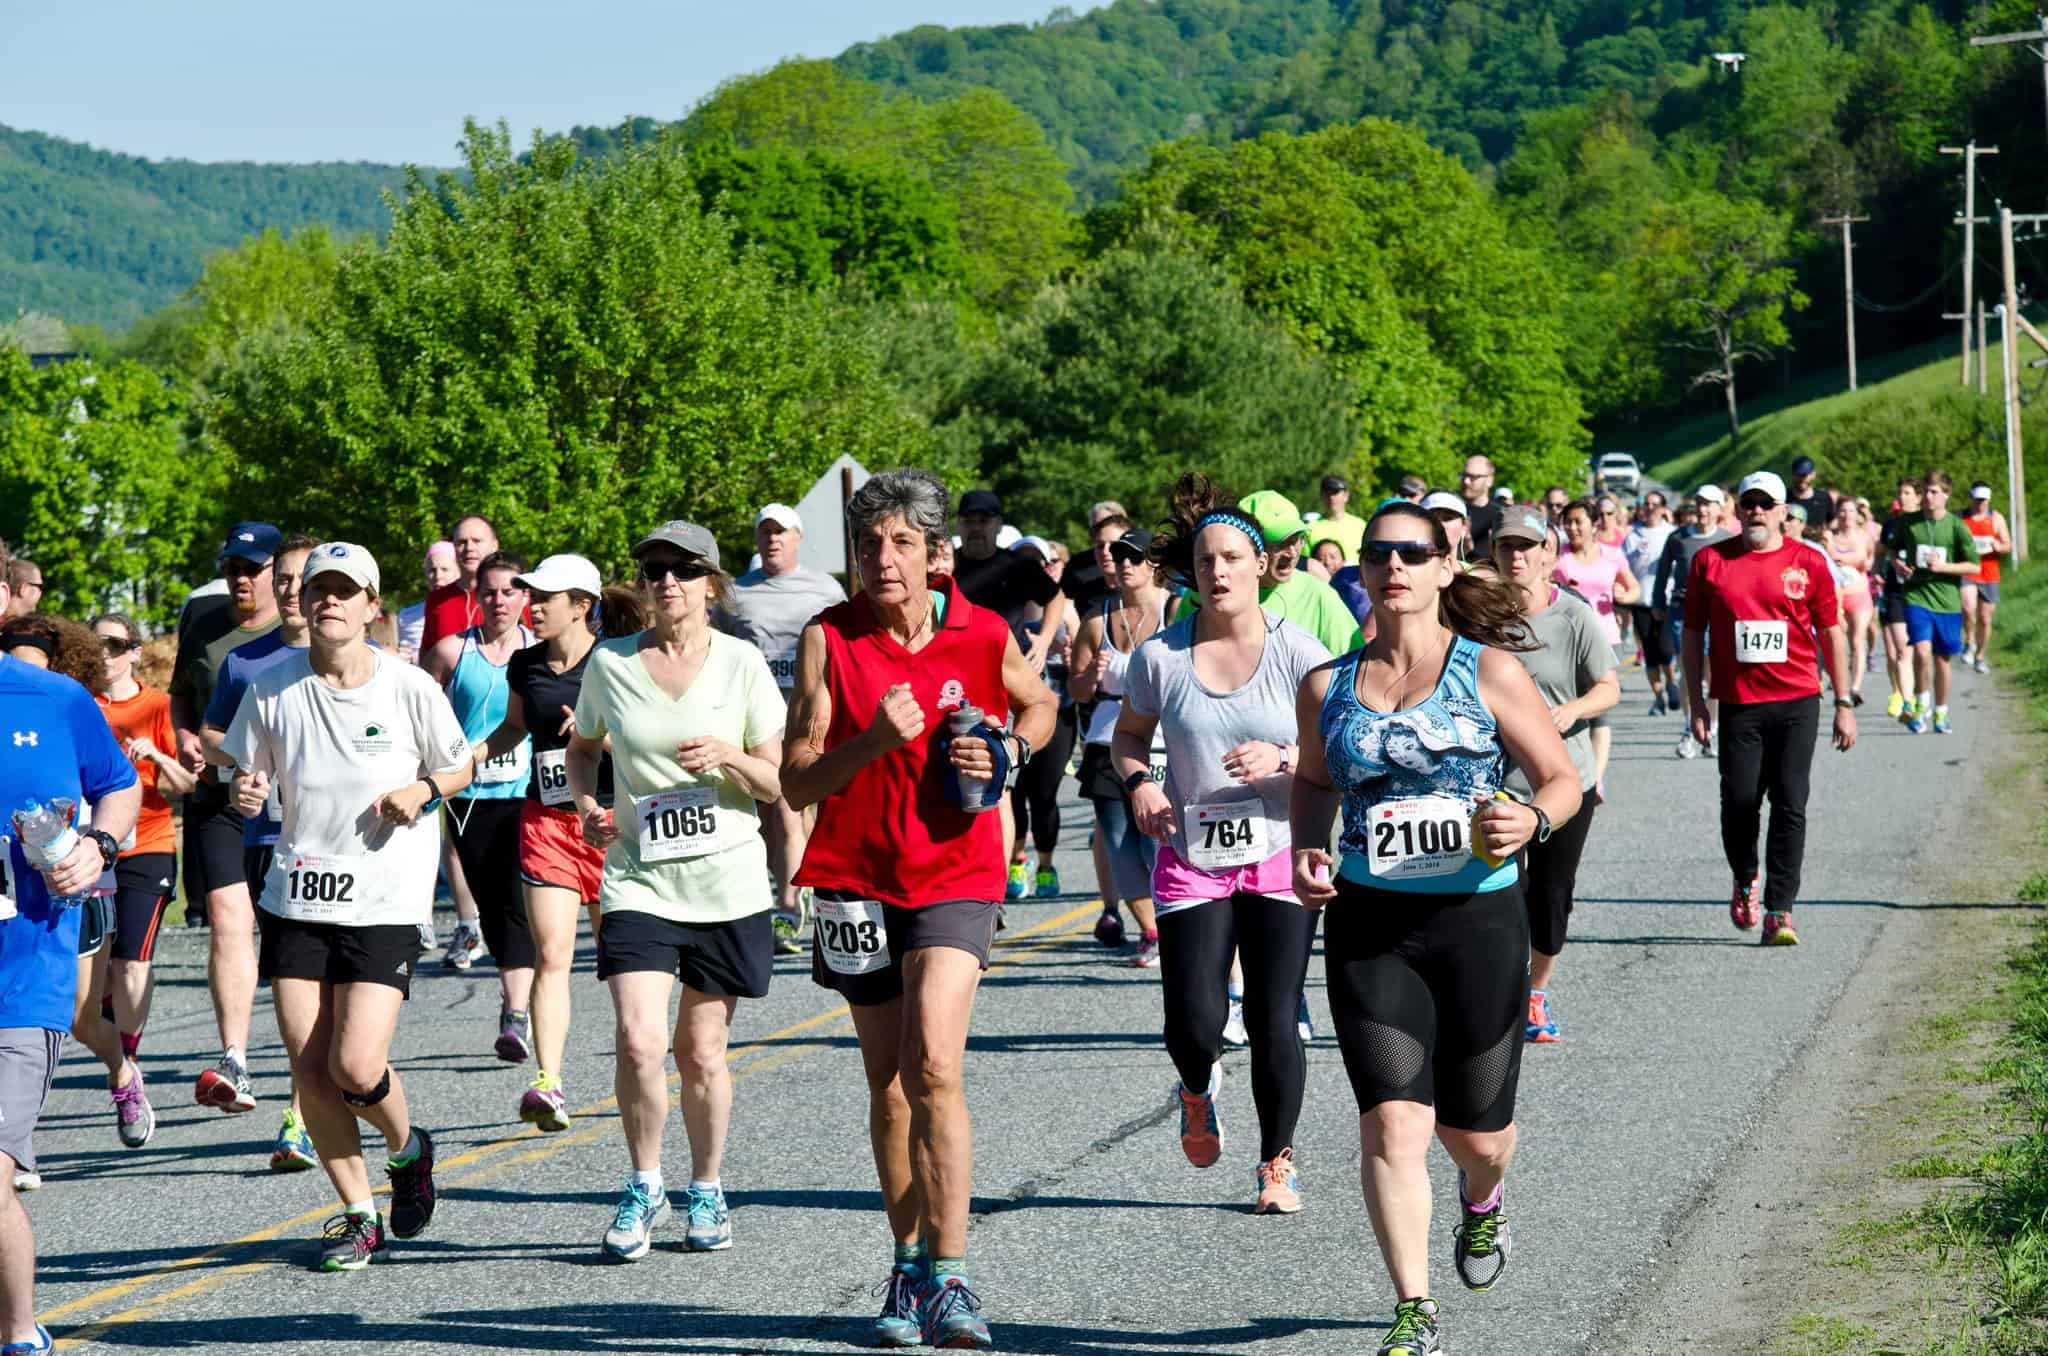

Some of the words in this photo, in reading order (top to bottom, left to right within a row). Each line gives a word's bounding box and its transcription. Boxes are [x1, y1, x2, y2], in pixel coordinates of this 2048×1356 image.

[1741, 632, 1784, 650] 1479
[645, 804, 716, 841] 1065
[1199, 818, 1254, 849] 764
[1375, 819, 1462, 858] 2100
[289, 870, 354, 902] 1802
[816, 916, 880, 954] 1203
